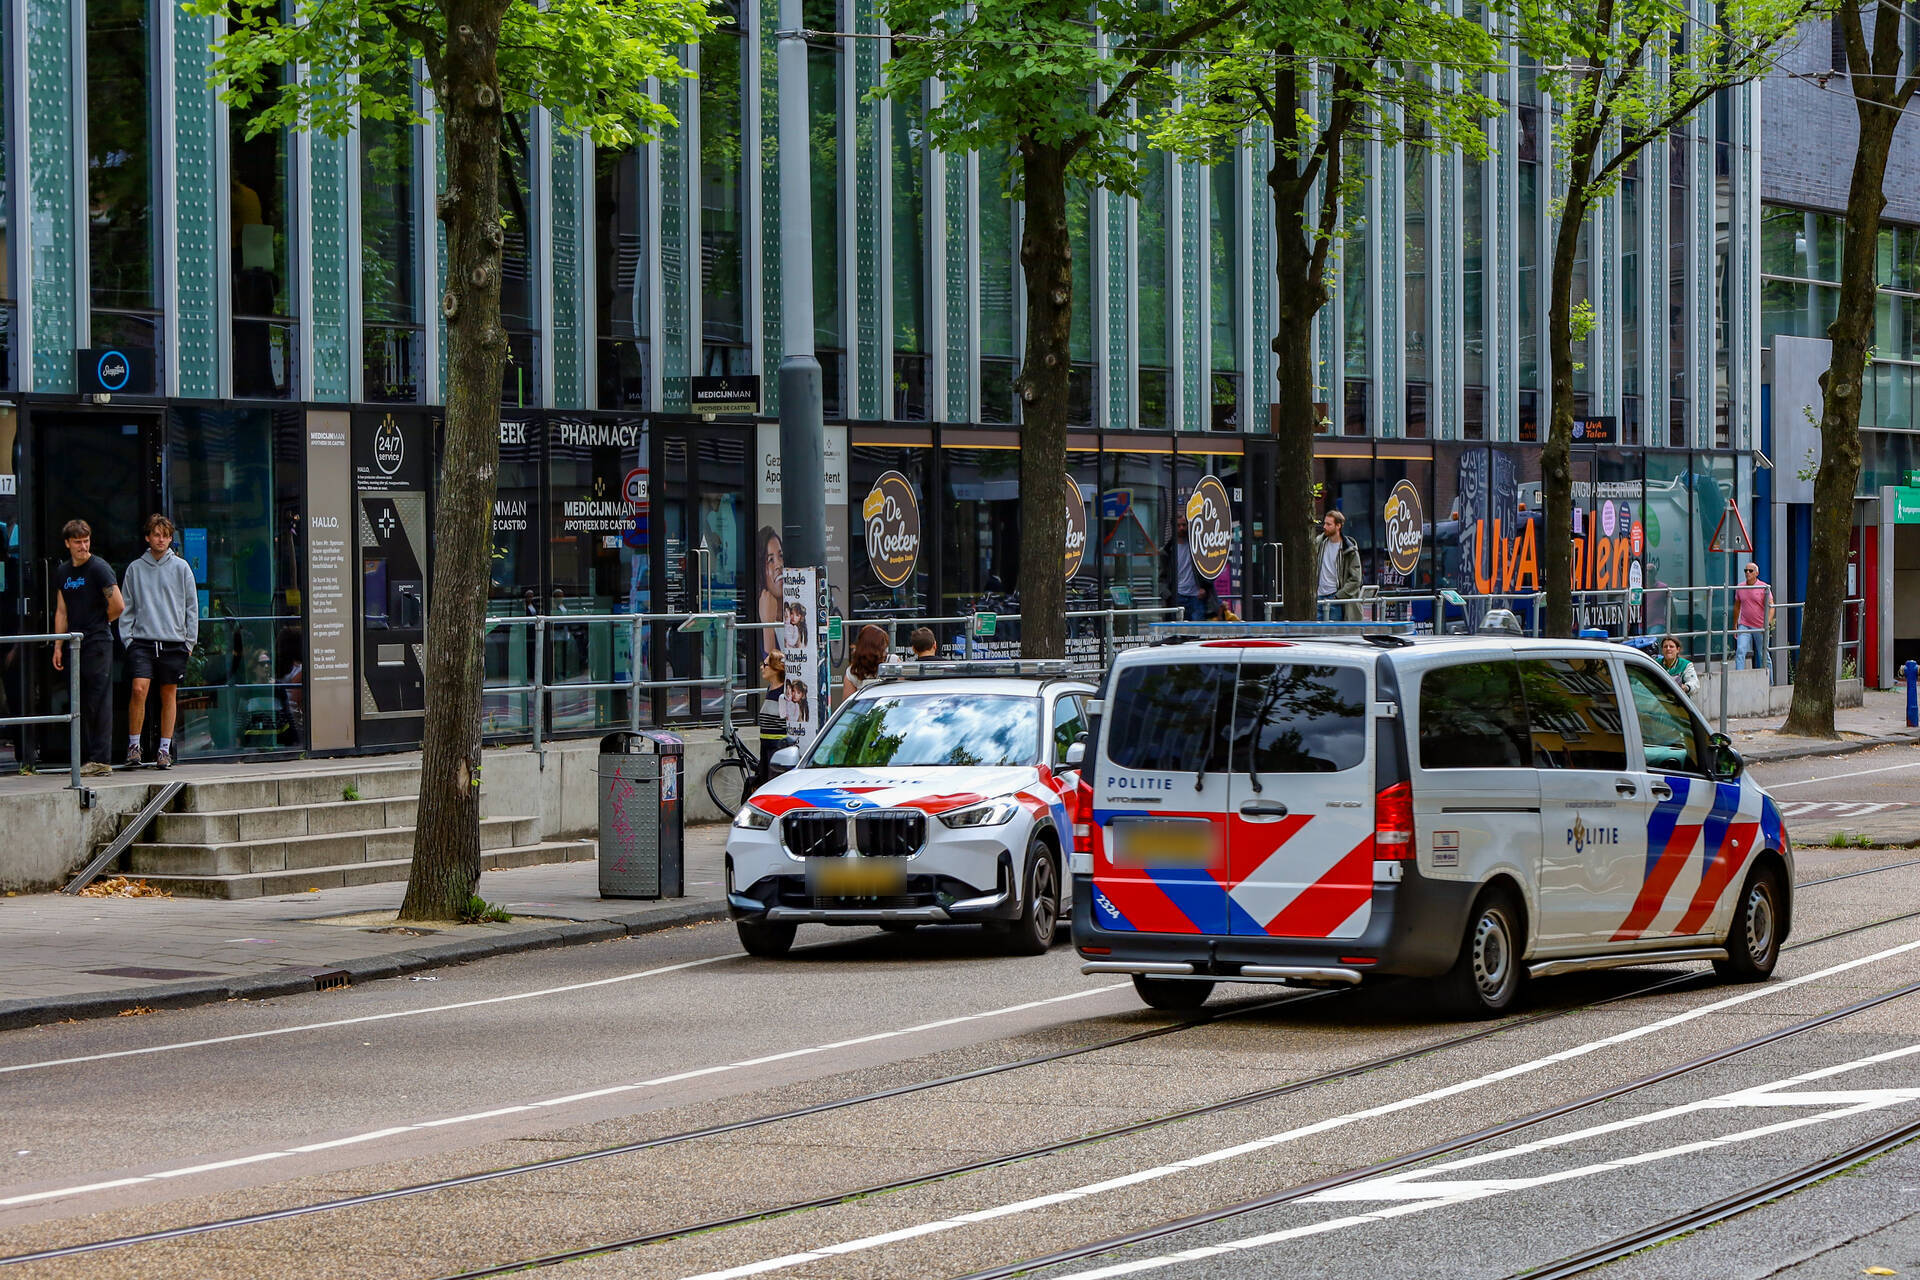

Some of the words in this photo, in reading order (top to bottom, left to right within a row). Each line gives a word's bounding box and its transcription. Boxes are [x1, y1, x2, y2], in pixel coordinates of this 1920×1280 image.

[698, 390, 751, 399] MEDICIJNMAN
[1585, 421, 1602, 430] UvA
[310, 432, 345, 440] MEDICIJNMAN
[560, 424, 638, 447] PHARMACY
[1586, 430, 1607, 439] Talen
[379, 436, 400, 452] 24/7
[379, 452, 400, 461] service
[638, 484, 647, 494] 19
[1571, 481, 1607, 498] ANGUAGE
[1607, 481, 1642, 498] LEARNING
[564, 501, 637, 517] MEDICIJNMAN
[885, 496, 902, 522] De
[1204, 498, 1218, 520] De
[1400, 500, 1411, 522] De
[312, 516, 340, 529] HALLO,
[498, 519, 527, 531] CASTRO
[564, 519, 600, 531] APOTHEEK
[600, 520, 609, 530] DE
[609, 520, 637, 531] CASTRO
[869, 516, 918, 561] Roeter
[1191, 517, 1231, 556] Roeter
[1388, 518, 1423, 554] Roeter
[1474, 517, 1540, 595] UvA
[1571, 510, 1630, 590] alen
[1107, 776, 1173, 790] POLITIE
[1567, 827, 1619, 854] POLITIE
[1096, 894, 1121, 919] 2324
